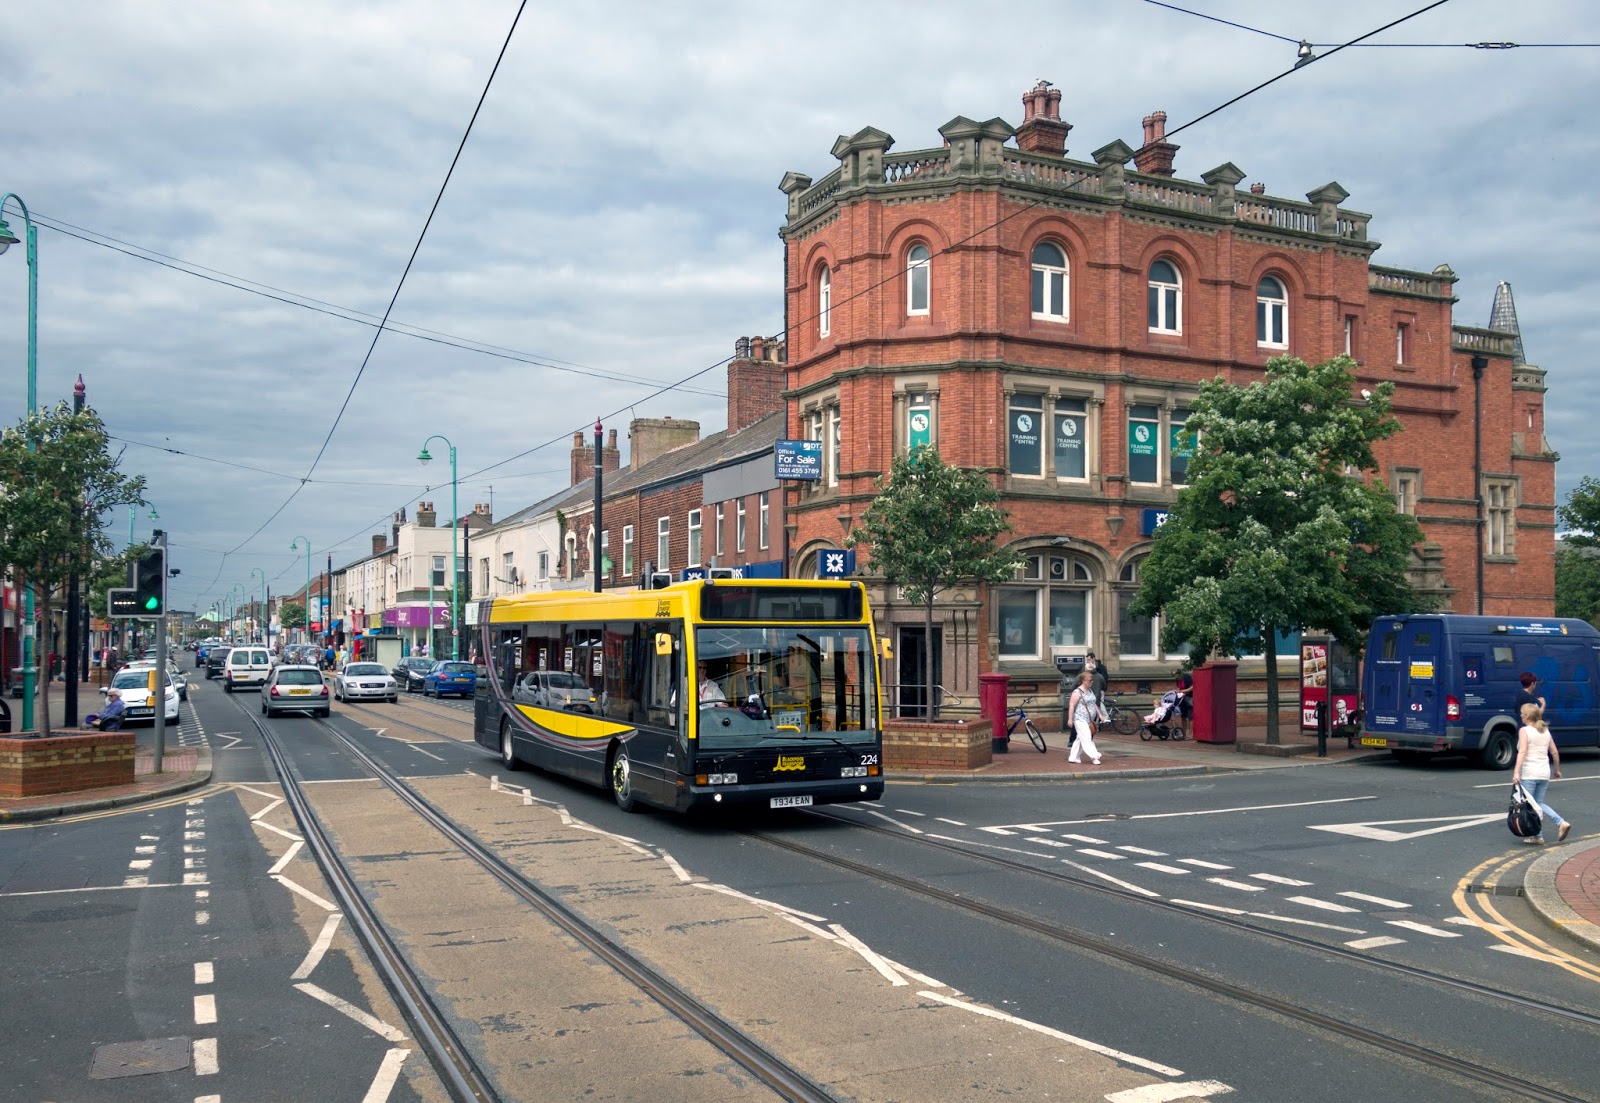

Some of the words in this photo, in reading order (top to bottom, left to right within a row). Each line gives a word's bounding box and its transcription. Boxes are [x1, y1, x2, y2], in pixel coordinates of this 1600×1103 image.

[778, 454, 794, 463] For
[797, 455, 816, 464] Sale
[1410, 703, 1423, 712] G4S
[861, 754, 878, 766] 224
[774, 798, 793, 806] T934
[796, 796, 810, 804] EAN
